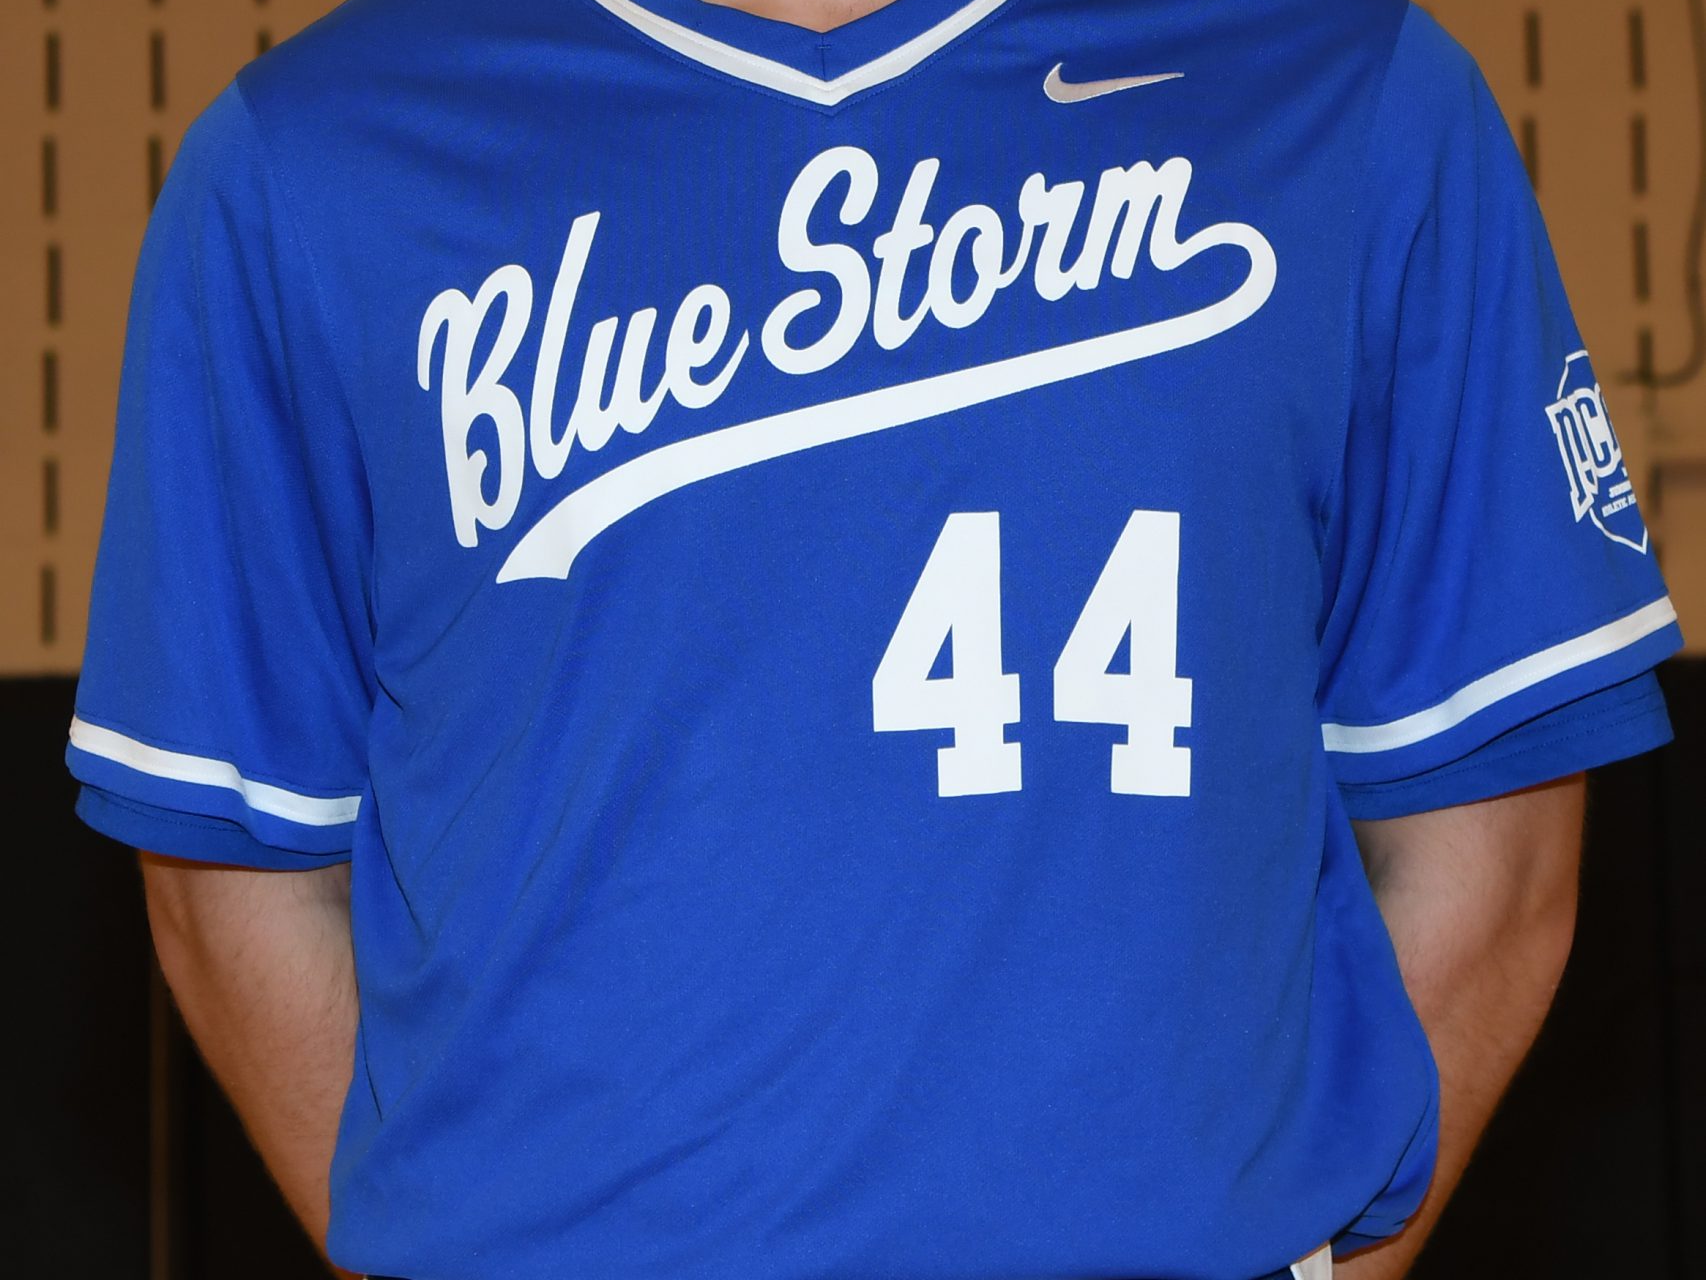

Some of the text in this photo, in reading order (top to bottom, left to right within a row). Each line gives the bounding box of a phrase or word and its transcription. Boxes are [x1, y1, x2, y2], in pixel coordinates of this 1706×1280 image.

[418, 146, 1204, 548] Blue Storm
[873, 509, 1193, 798] 44
